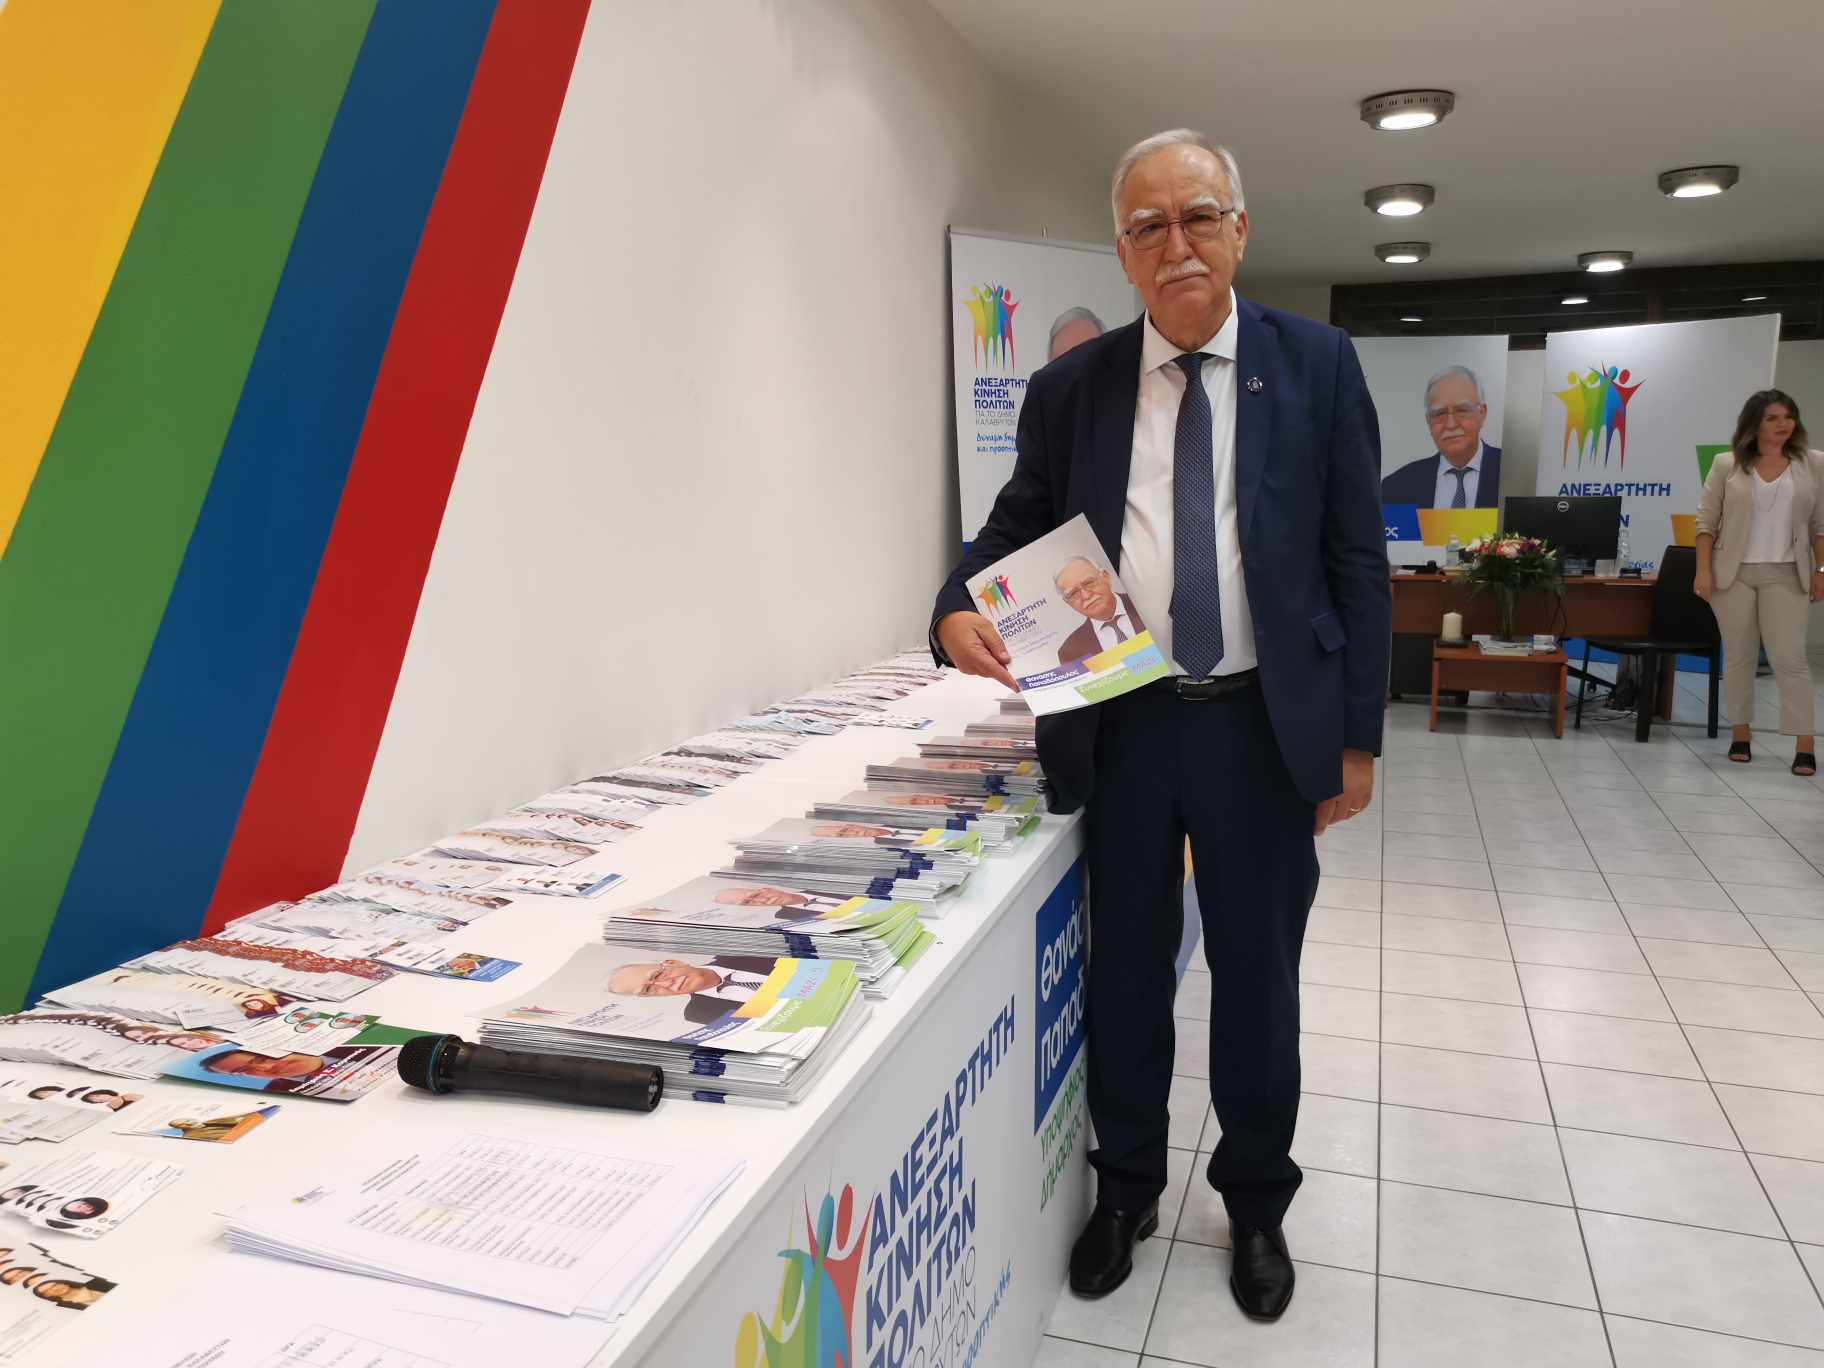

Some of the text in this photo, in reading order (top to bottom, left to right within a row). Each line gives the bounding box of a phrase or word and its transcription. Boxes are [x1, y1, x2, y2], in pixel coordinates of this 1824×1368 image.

[974, 388, 1009, 398] ΚΙΝΗΣΗ
[975, 399, 1015, 410] ΠΟΛΙΤΩΝ
[1558, 483, 1671, 497] ΑΝΕΞΑΡΤΗΤΗ
[997, 597, 1047, 628] ΑΝΕΞΑΡΤΗΤΗ
[1001, 618, 1037, 640] ΠΟΛΙΤΩΝ
[867, 993, 1015, 1275] ΑΝΕΞΑΡΤΗΤΗ
[866, 1136, 963, 1355] ΚΙΝΗΣΗ
[930, 1246, 976, 1363] ΔΗΜΟ
